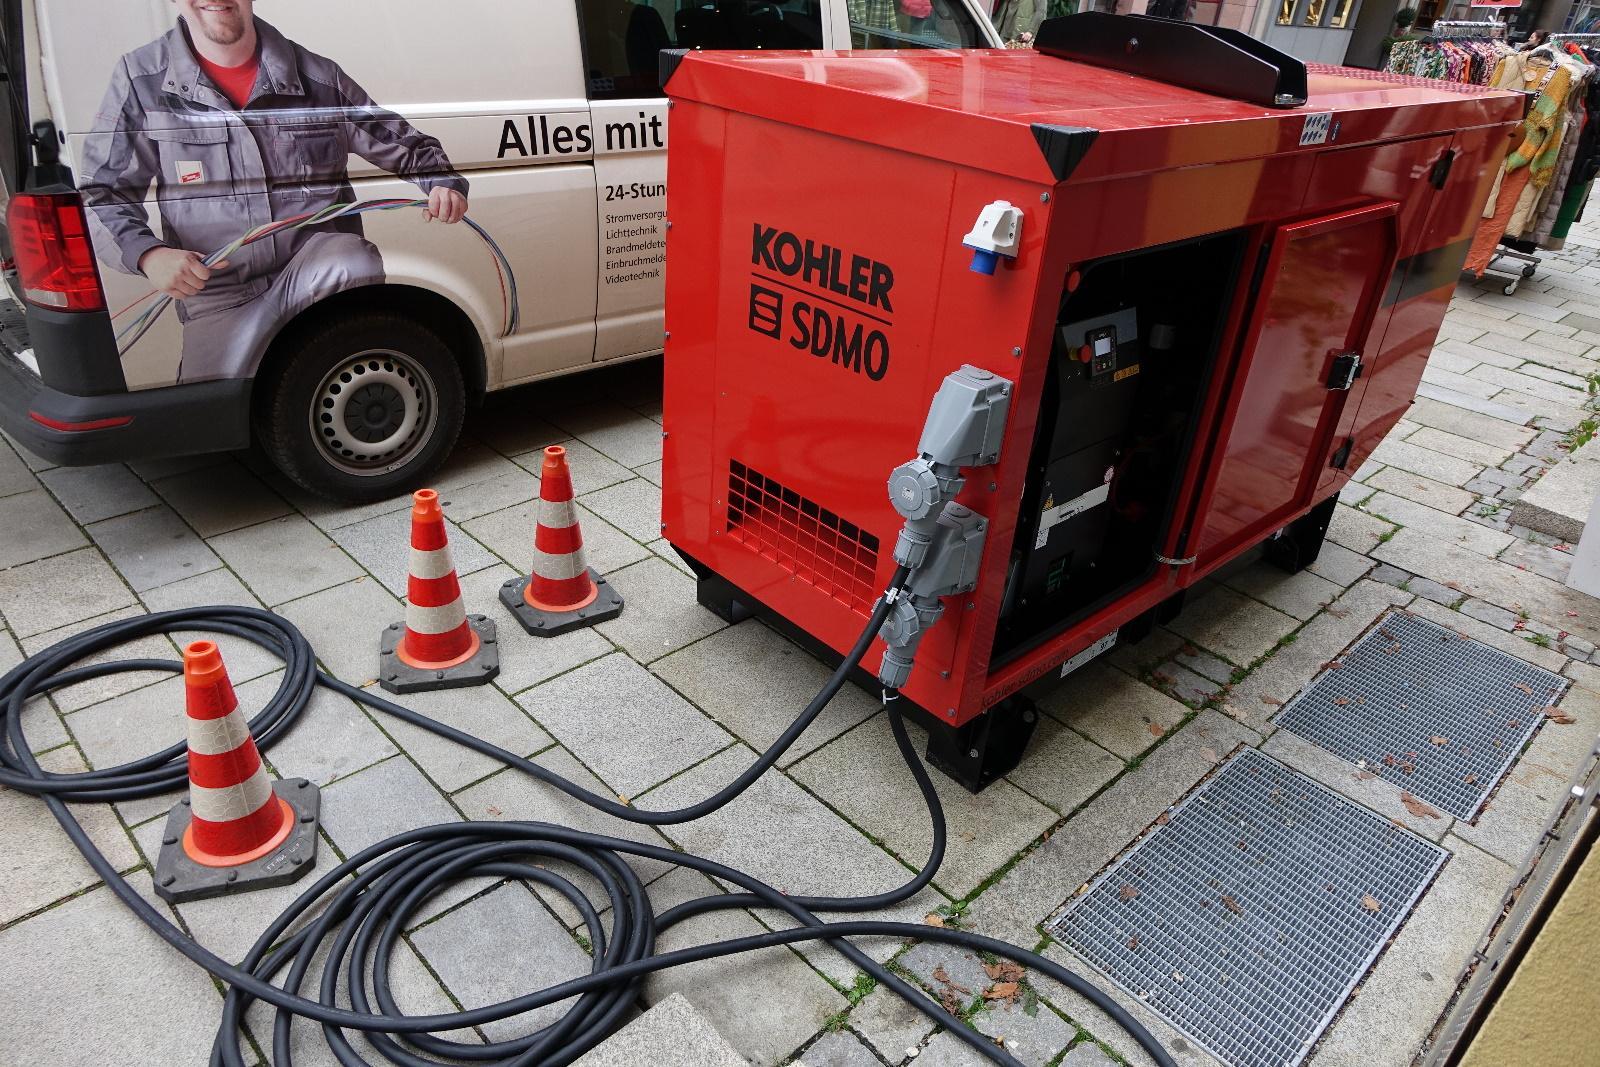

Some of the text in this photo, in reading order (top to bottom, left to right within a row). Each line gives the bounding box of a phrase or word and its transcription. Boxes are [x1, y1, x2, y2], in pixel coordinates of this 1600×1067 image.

[497, 111, 664, 159] Alles mit
[605, 182, 667, 202] 24-Stun
[606, 225, 658, 240] Lichttechnik
[606, 239, 666, 255] Brandmeldete
[605, 269, 660, 285] Videotechnik
[751, 222, 895, 314] KOHLER
[789, 300, 890, 383] SDMO
